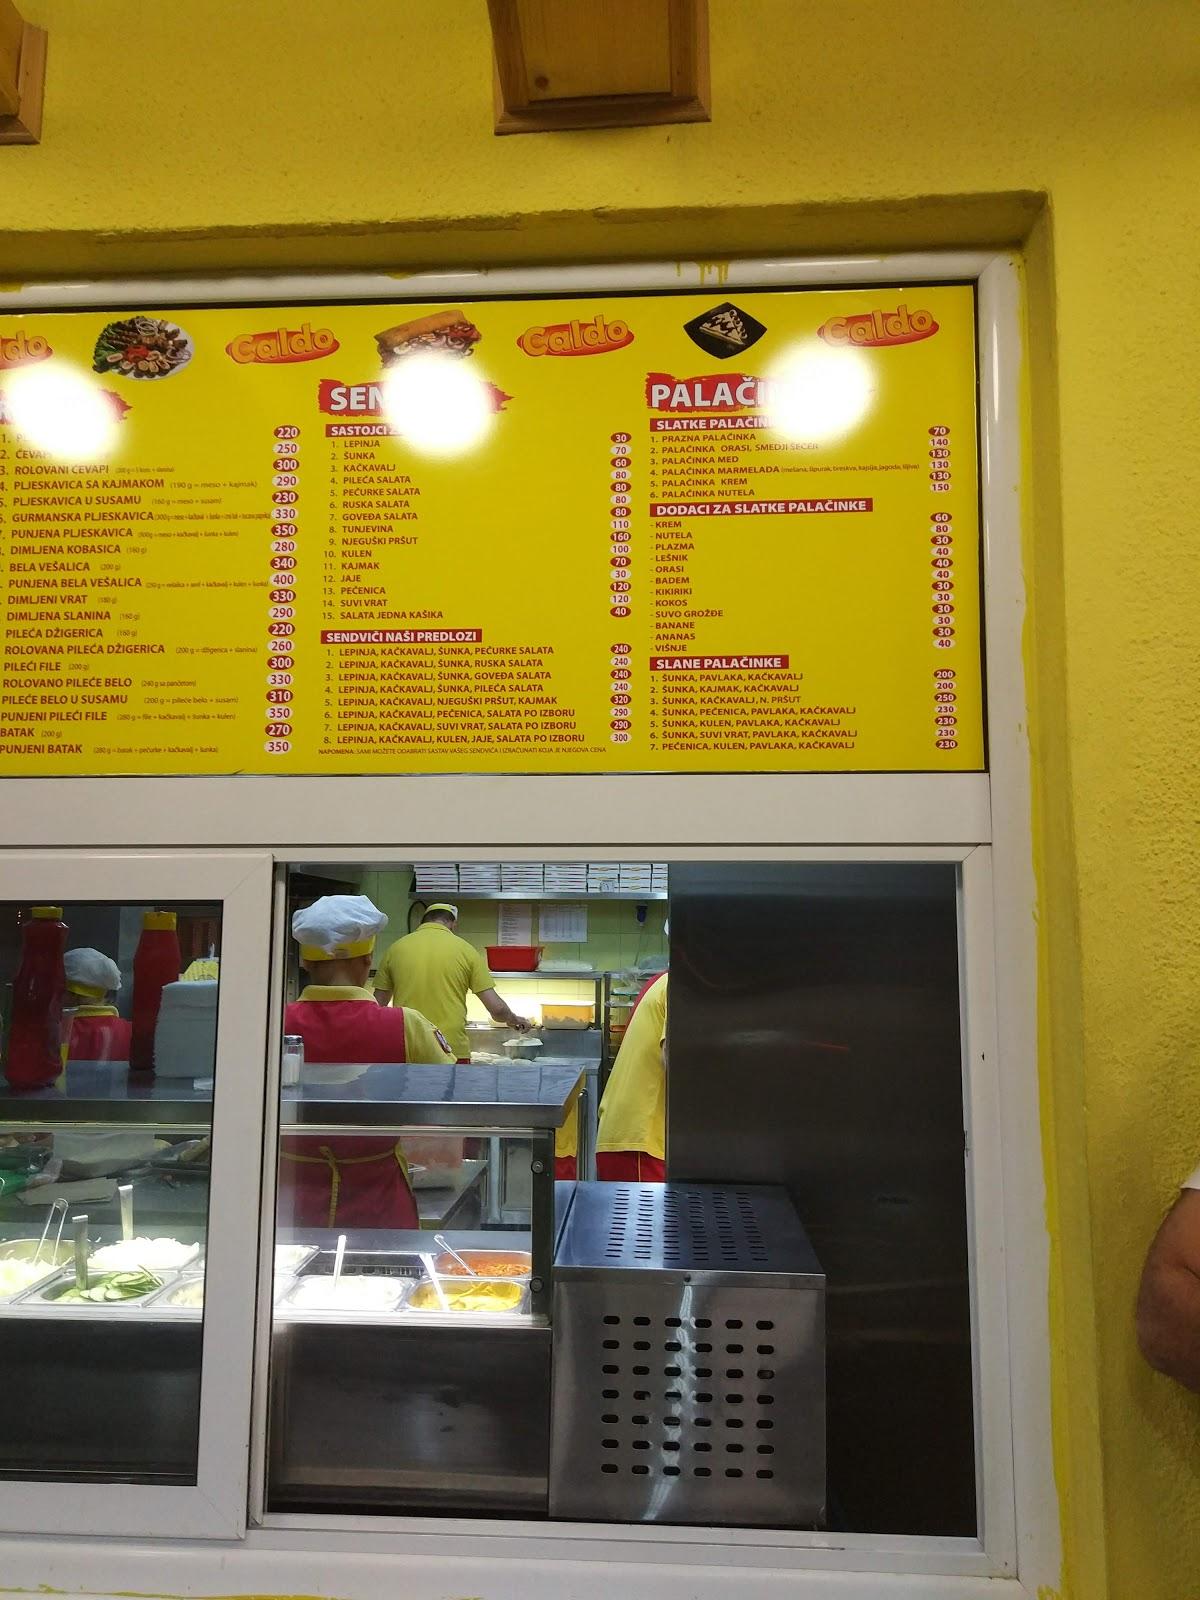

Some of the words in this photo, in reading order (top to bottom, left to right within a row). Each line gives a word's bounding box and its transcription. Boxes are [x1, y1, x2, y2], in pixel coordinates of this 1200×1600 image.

[823, 304, 933, 348] Caldo
[522, 314, 628, 357] Caldo
[232, 322, 334, 364] Caldo
[657, 419, 706, 429] SLATKE
[278, 428, 298, 437] 220
[332, 426, 386, 435] SASTOJCI
[278, 444, 297, 453] 250
[344, 451, 374, 459] ŠUNKA
[277, 460, 297, 470] 300
[15, 466, 68, 475] ROLOVANI
[14, 480, 82, 490] PLJESKAVICA
[86, 480, 99, 488] SA
[102, 479, 164, 488] KAJMAKOM
[277, 476, 296, 486] 290
[13, 496, 82, 506] PLJESKAVICA
[85, 496, 92, 504] U
[95, 495, 140, 504] SUSAMU
[276, 493, 296, 502] 230
[276, 509, 295, 518] 330
[657, 505, 709, 515] DODACI
[713, 504, 731, 513] ZA
[734, 503, 785, 513] SLATKE
[12, 512, 81, 522] GURMANSKA
[84, 511, 153, 521] PLJESKAVICA
[342, 536, 386, 545] NJEGUŠKI
[388, 536, 417, 544] PRŠUT
[10, 545, 64, 554] DIMLJENA
[67, 544, 120, 554] KOBASICA
[655, 553, 687, 561] LEŠNIK
[9, 562, 36, 571] BELA
[38, 560, 89, 571] VEŠALICA
[6, 611, 60, 620] DIMLJENA
[63, 611, 110, 620] SLANINA
[409, 609, 442, 618] KAŠIKA
[386, 630, 414, 641] NAŠI
[417, 631, 476, 641] PREDLOZI
[4, 645, 64, 654] ROLOVANA
[107, 642, 164, 653] DŽIGERICA
[272, 641, 291, 650] 260
[39, 662, 60, 671] FILE
[271, 658, 292, 668] 300
[656, 659, 700, 668] SLANE
[271, 675, 291, 684] 330
[662, 673, 697, 682] ŠUNKA,
[3, 678, 63, 688] ROLOVANO
[104, 678, 132, 686] BELO
[662, 696, 697, 704] ŠUNKA,
[1, 712, 46, 721] PUNJENI
[85, 712, 106, 720] FILE
[0, 728, 34, 736] BATAK
[269, 725, 290, 735] 270
[337, 736, 376, 744] LEPINJA,
[471, 735, 494, 743] JAJE,
[0, 744, 44, 753] PUNJENI
[47, 744, 82, 753] BATAK
[268, 742, 288, 751] 350
